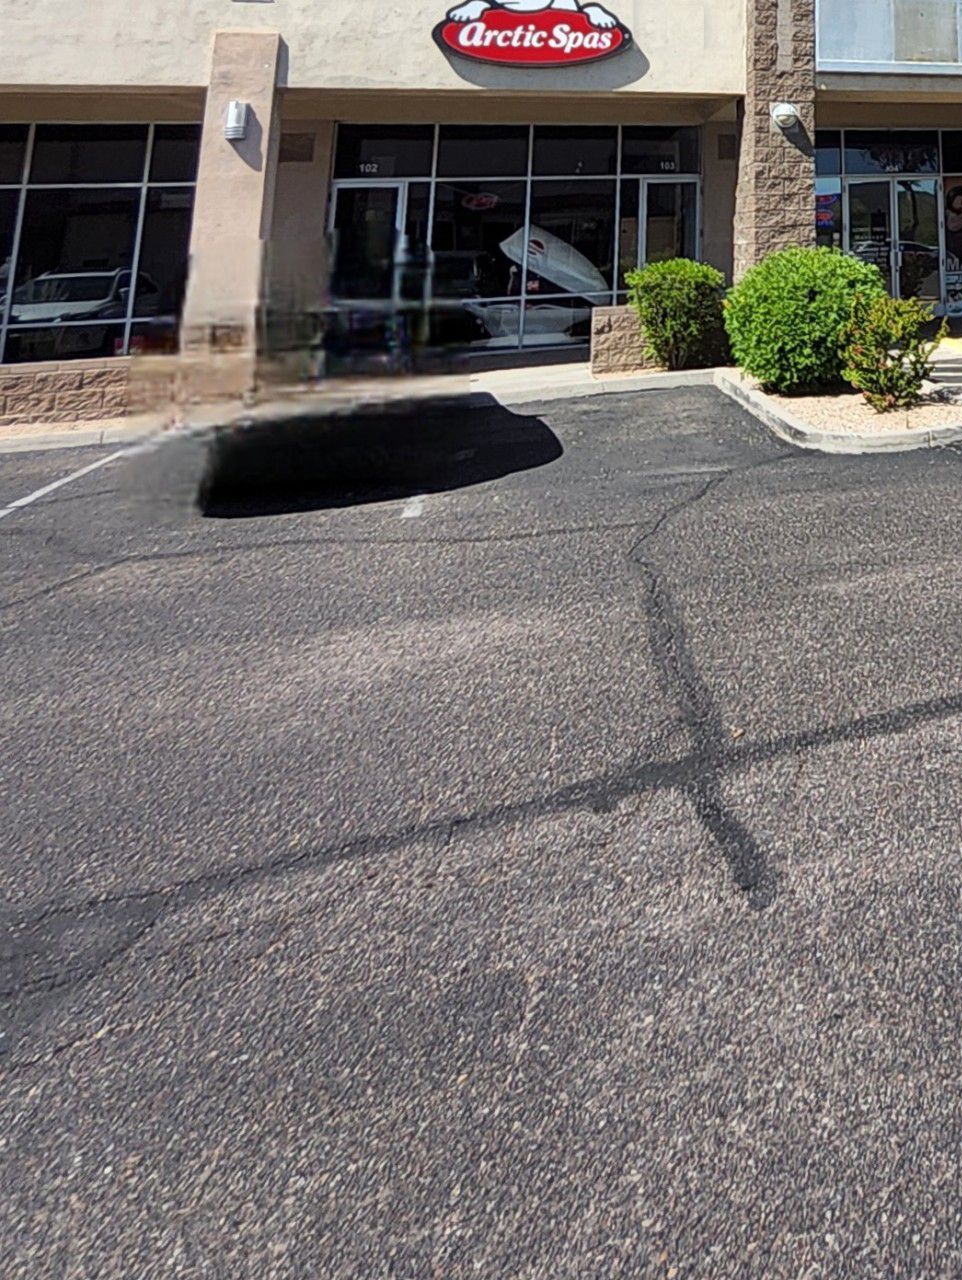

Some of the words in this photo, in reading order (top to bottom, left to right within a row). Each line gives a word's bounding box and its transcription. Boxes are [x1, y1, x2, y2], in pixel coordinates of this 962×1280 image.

[547, 24, 612, 53] Spas
[359, 163, 378, 173] 102
[660, 161, 675, 170] 103
